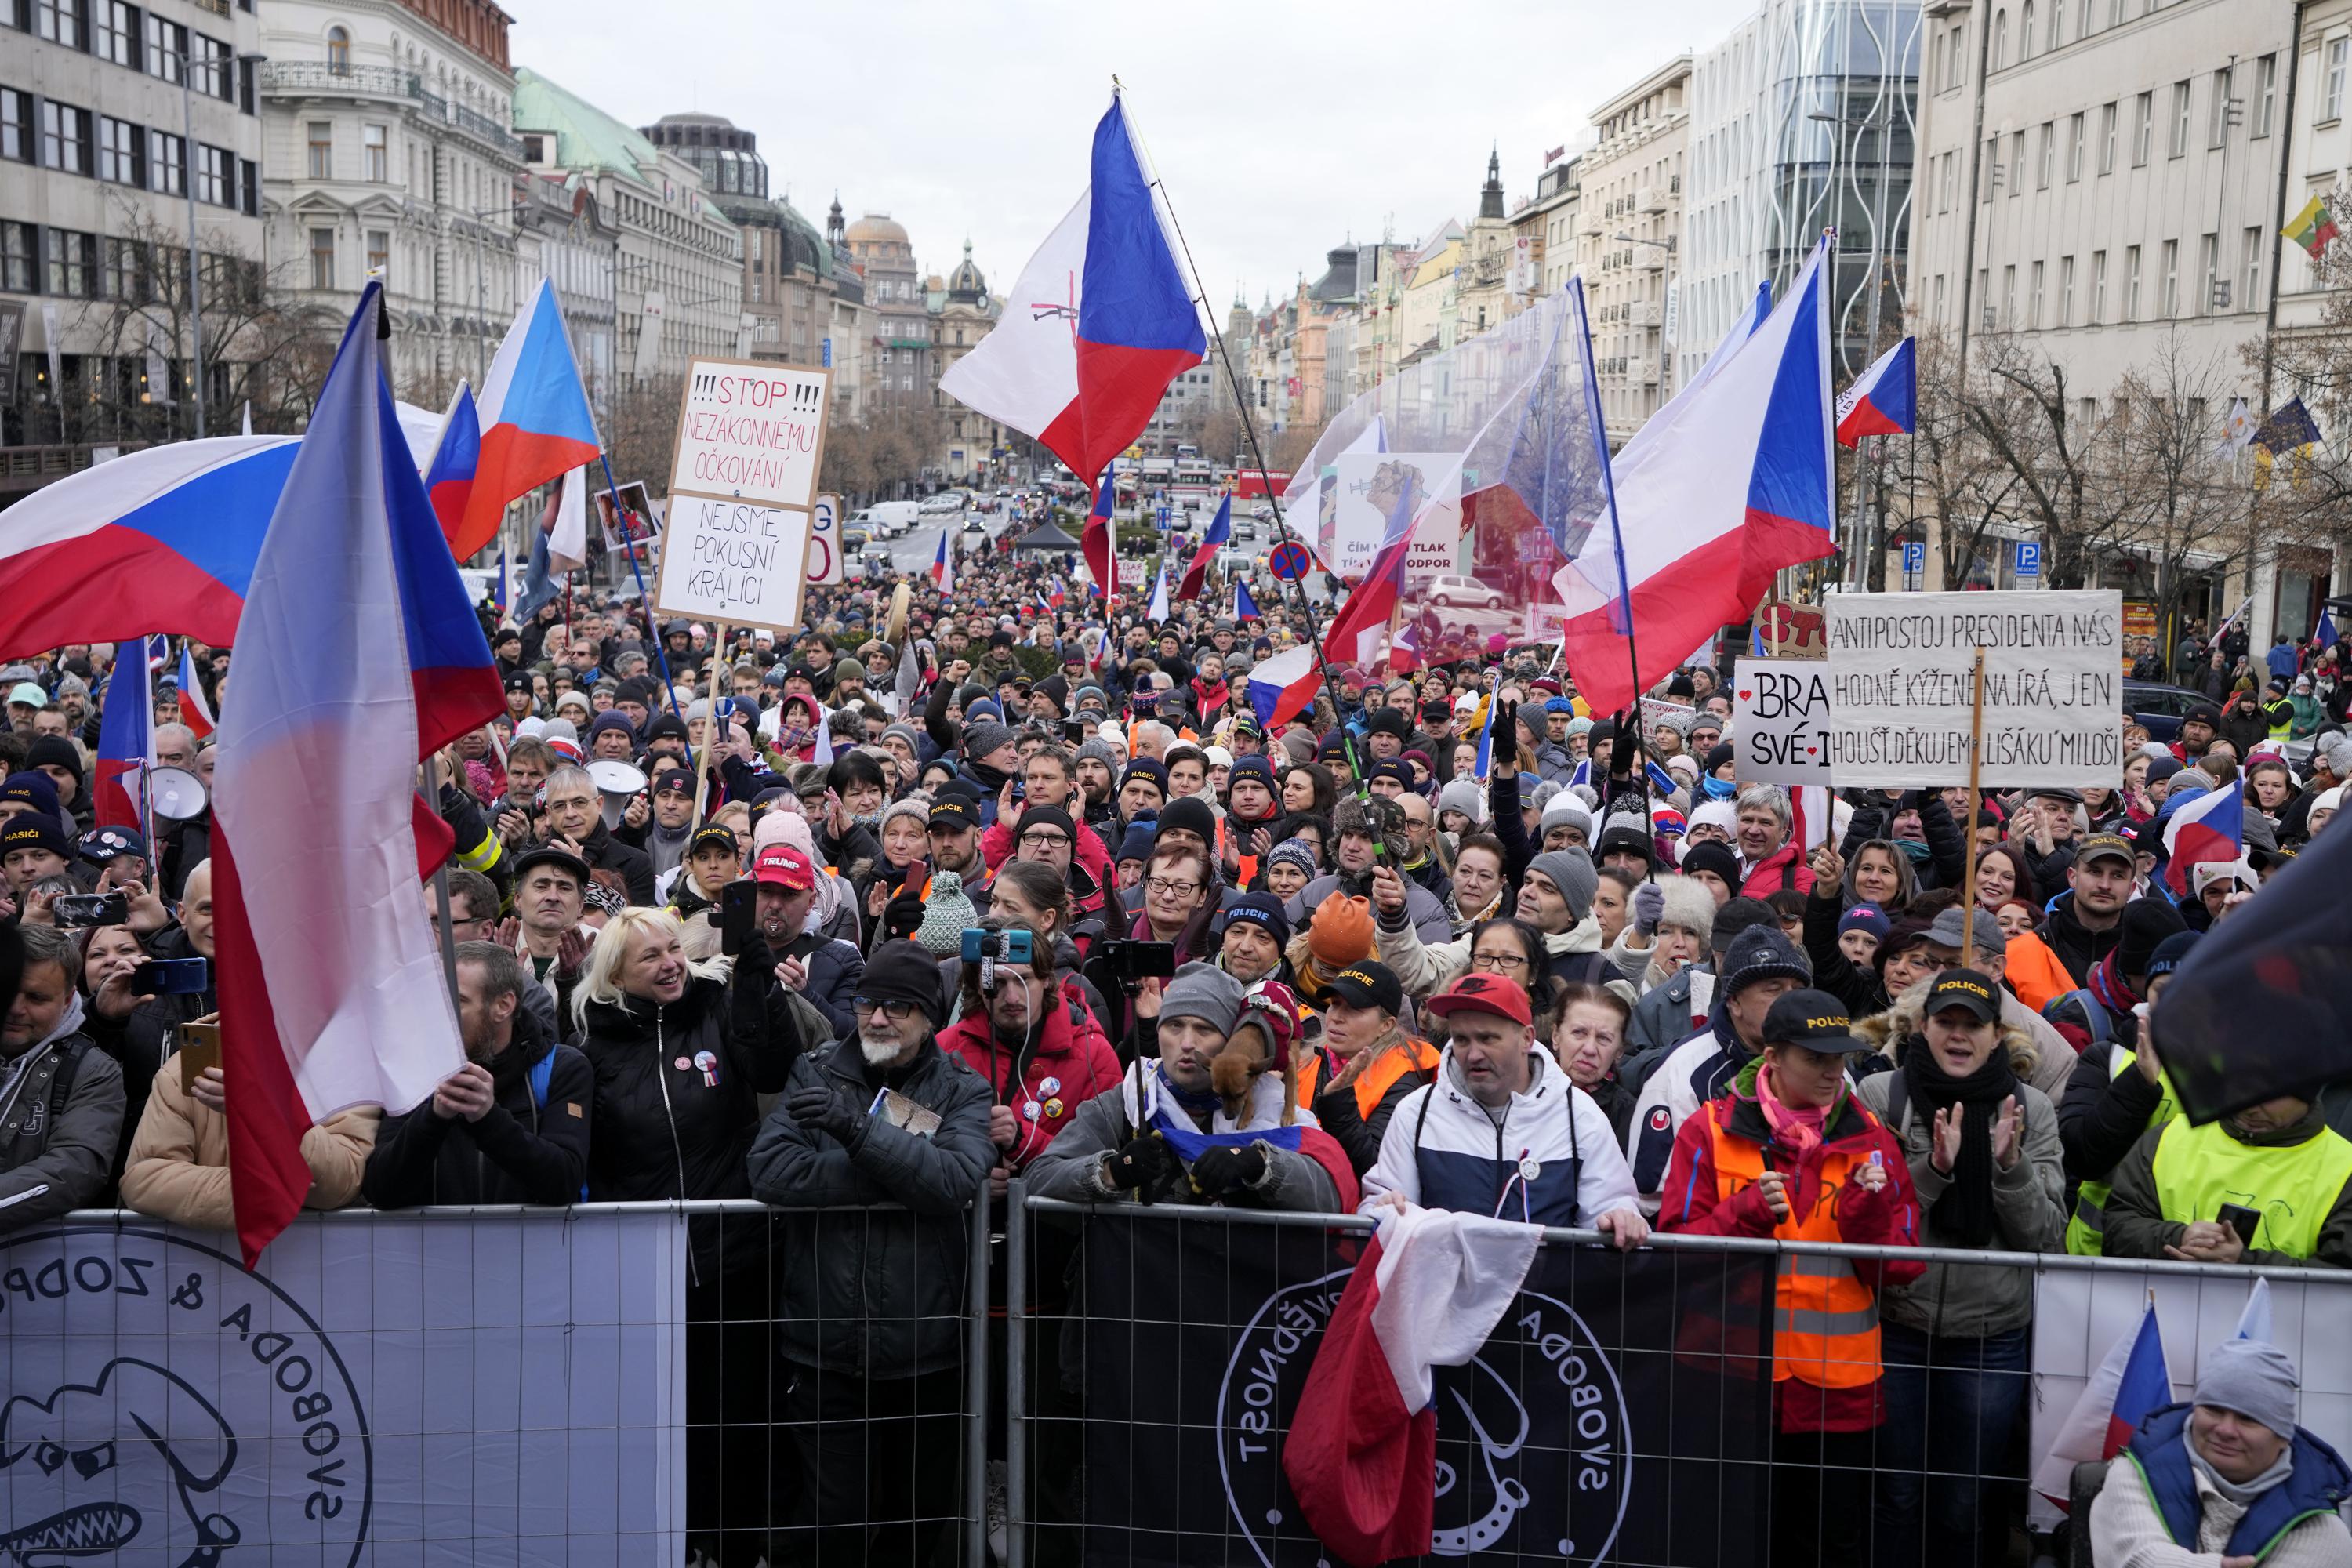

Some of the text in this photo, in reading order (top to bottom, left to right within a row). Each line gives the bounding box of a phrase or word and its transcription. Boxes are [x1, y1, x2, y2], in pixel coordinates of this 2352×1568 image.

[1516, 253, 1526, 304] RAMAA
[1668, 289, 1678, 335] PRIMARK
[718, 376, 788, 408] STOP
[684, 408, 815, 453] NEZÁKONNÉMU
[695, 447, 789, 489] OČKOVÁNÍ
[699, 503, 782, 538] NEJSME
[692, 535, 779, 571] POKUSNÍ
[1347, 541, 1370, 553] ČÍM
[1414, 543, 1446, 552] TLAK
[1908, 546, 1921, 564] P
[2021, 546, 2036, 565] P
[1406, 559, 1450, 568] ODPOR
[1952, 614, 2065, 648] PRESIDENTA
[2074, 608, 2114, 647] NÁS
[1751, 672, 1830, 719] BRA
[1835, 667, 1900, 707] HODNĚ
[2063, 673, 2111, 706] JEN
[1751, 721, 1806, 765] SVÉ
[2060, 728, 2118, 767] MILOŠI
[1131, 771, 1156, 781] HASIČI
[753, 801, 770, 811] HASIČ
[931, 804, 964, 815] POLICIE
[5, 829, 38, 842] HASIČI
[695, 828, 731, 840] POLICIE
[2089, 837, 2129, 850] POLICIE
[96, 848, 114, 858] HH
[763, 857, 800, 869] TRUMP
[1229, 908, 1270, 921] POLICIE
[1336, 969, 1375, 987] POLICIE
[1938, 980, 1990, 999] POLICIE
[1806, 1015, 1851, 1029] POLICIE
